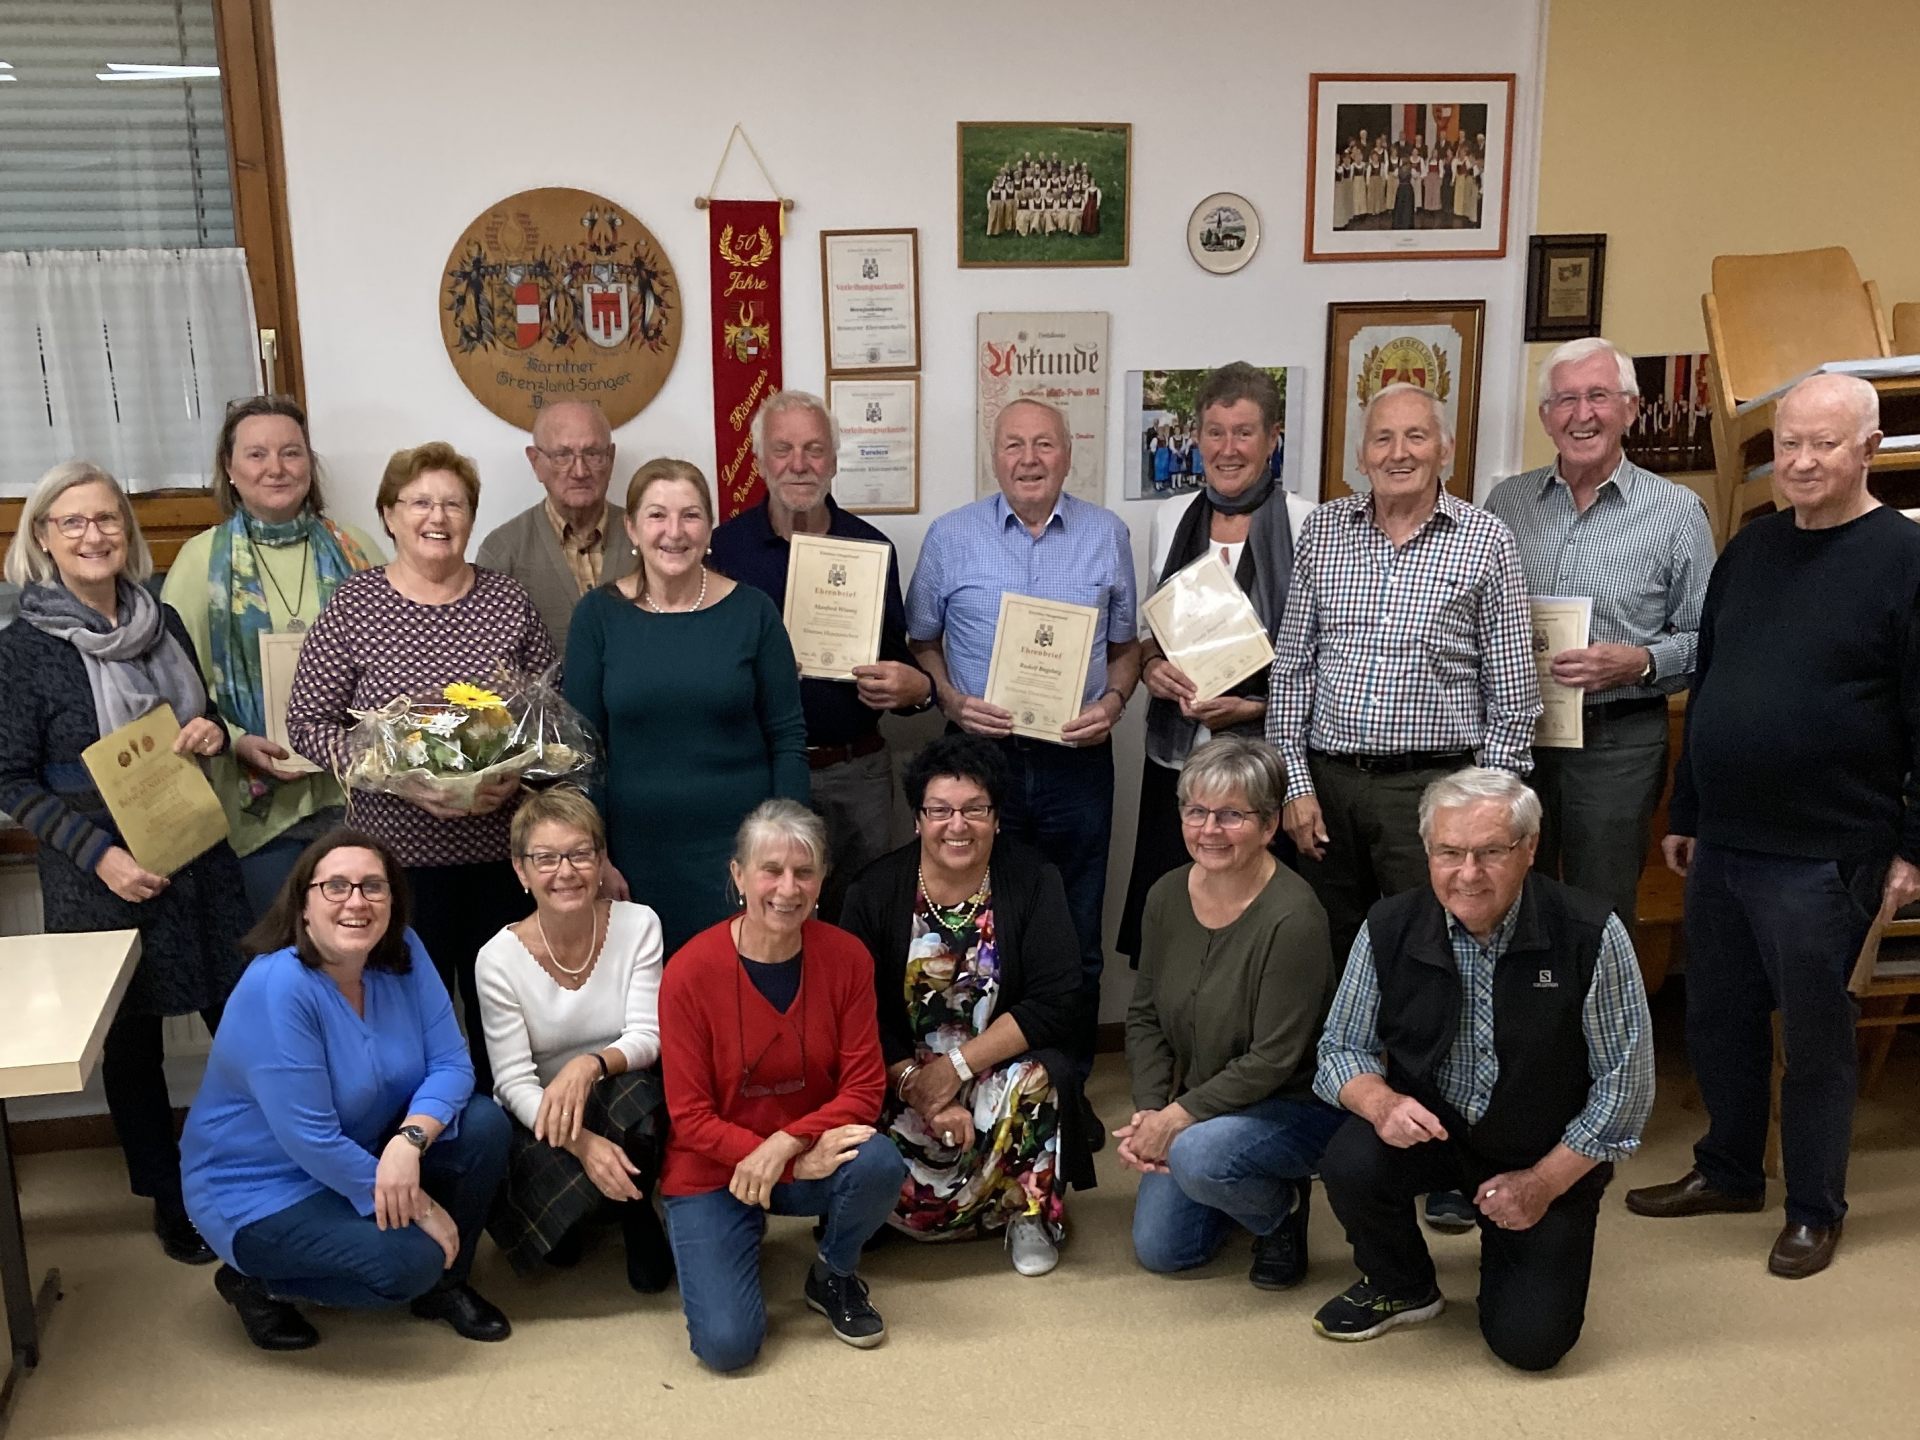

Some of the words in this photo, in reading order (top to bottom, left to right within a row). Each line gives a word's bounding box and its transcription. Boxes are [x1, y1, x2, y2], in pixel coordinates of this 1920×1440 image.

[734, 234, 757, 251] 50
[723, 271, 768, 297] Jahre
[987, 341, 1099, 377] Urkunde
